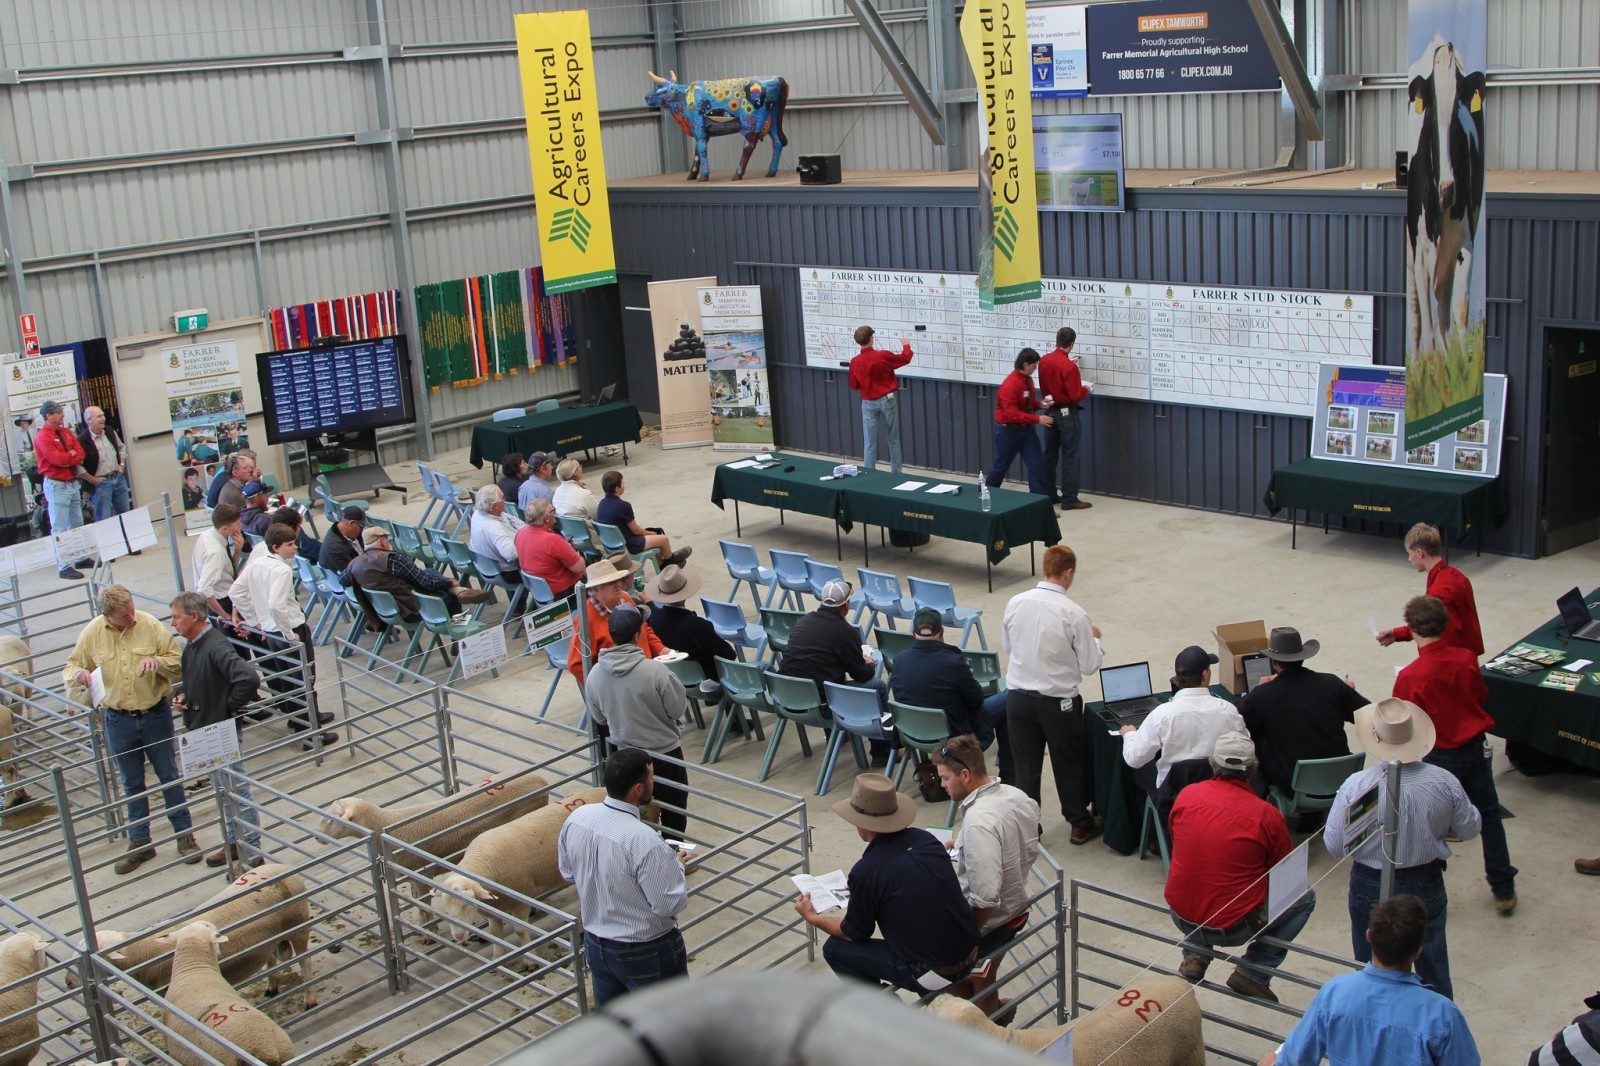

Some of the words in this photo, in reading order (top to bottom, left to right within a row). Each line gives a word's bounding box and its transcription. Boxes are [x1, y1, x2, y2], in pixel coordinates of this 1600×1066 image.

[1142, 17, 1165, 30] CLIPEX
[1166, 15, 1204, 28] TAMWORTH
[1000, 2, 1016, 75] Expo
[1142, 37, 1166, 46] Proudly
[1168, 36, 1205, 46] supporting
[1102, 51, 1123, 60] Farrer
[1124, 50, 1158, 59] Memorial
[1160, 46, 1203, 57] Agricultural
[1204, 46, 1221, 55] High
[1222, 44, 1248, 53] School
[564, 42, 584, 102] Expo
[1118, 70, 1134, 80] 1800
[1136, 69, 1144, 79] 65
[1146, 68, 1154, 78] 77
[1155, 68, 1165, 78] 66
[1180, 65, 1232, 77] CLIPEX.COM.AU
[534, 48, 572, 200] Agricultural
[1004, 88, 1020, 205] Careers
[572, 112, 591, 206] Careers
[832, 272, 864, 281] FARRER
[868, 274, 890, 283] STUD
[894, 275, 924, 284] STOCK
[1041, 282, 1067, 291] STUD
[1072, 284, 1106, 293] STOCK
[1193, 289, 1238, 300] FARRER
[1244, 291, 1275, 302] STUD
[1280, 294, 1322, 306] STOCK
[183, 347, 221, 358] FARRER
[25, 358, 61, 370] FARRER
[184, 356, 216, 364] MEMORIAL
[184, 360, 230, 371] AGRICULTURAL
[29, 367, 60, 376] MEMORIAL
[23, 373, 66, 385] AGRICULTURAL
[1558, 730, 1581, 742] PRODUCT
